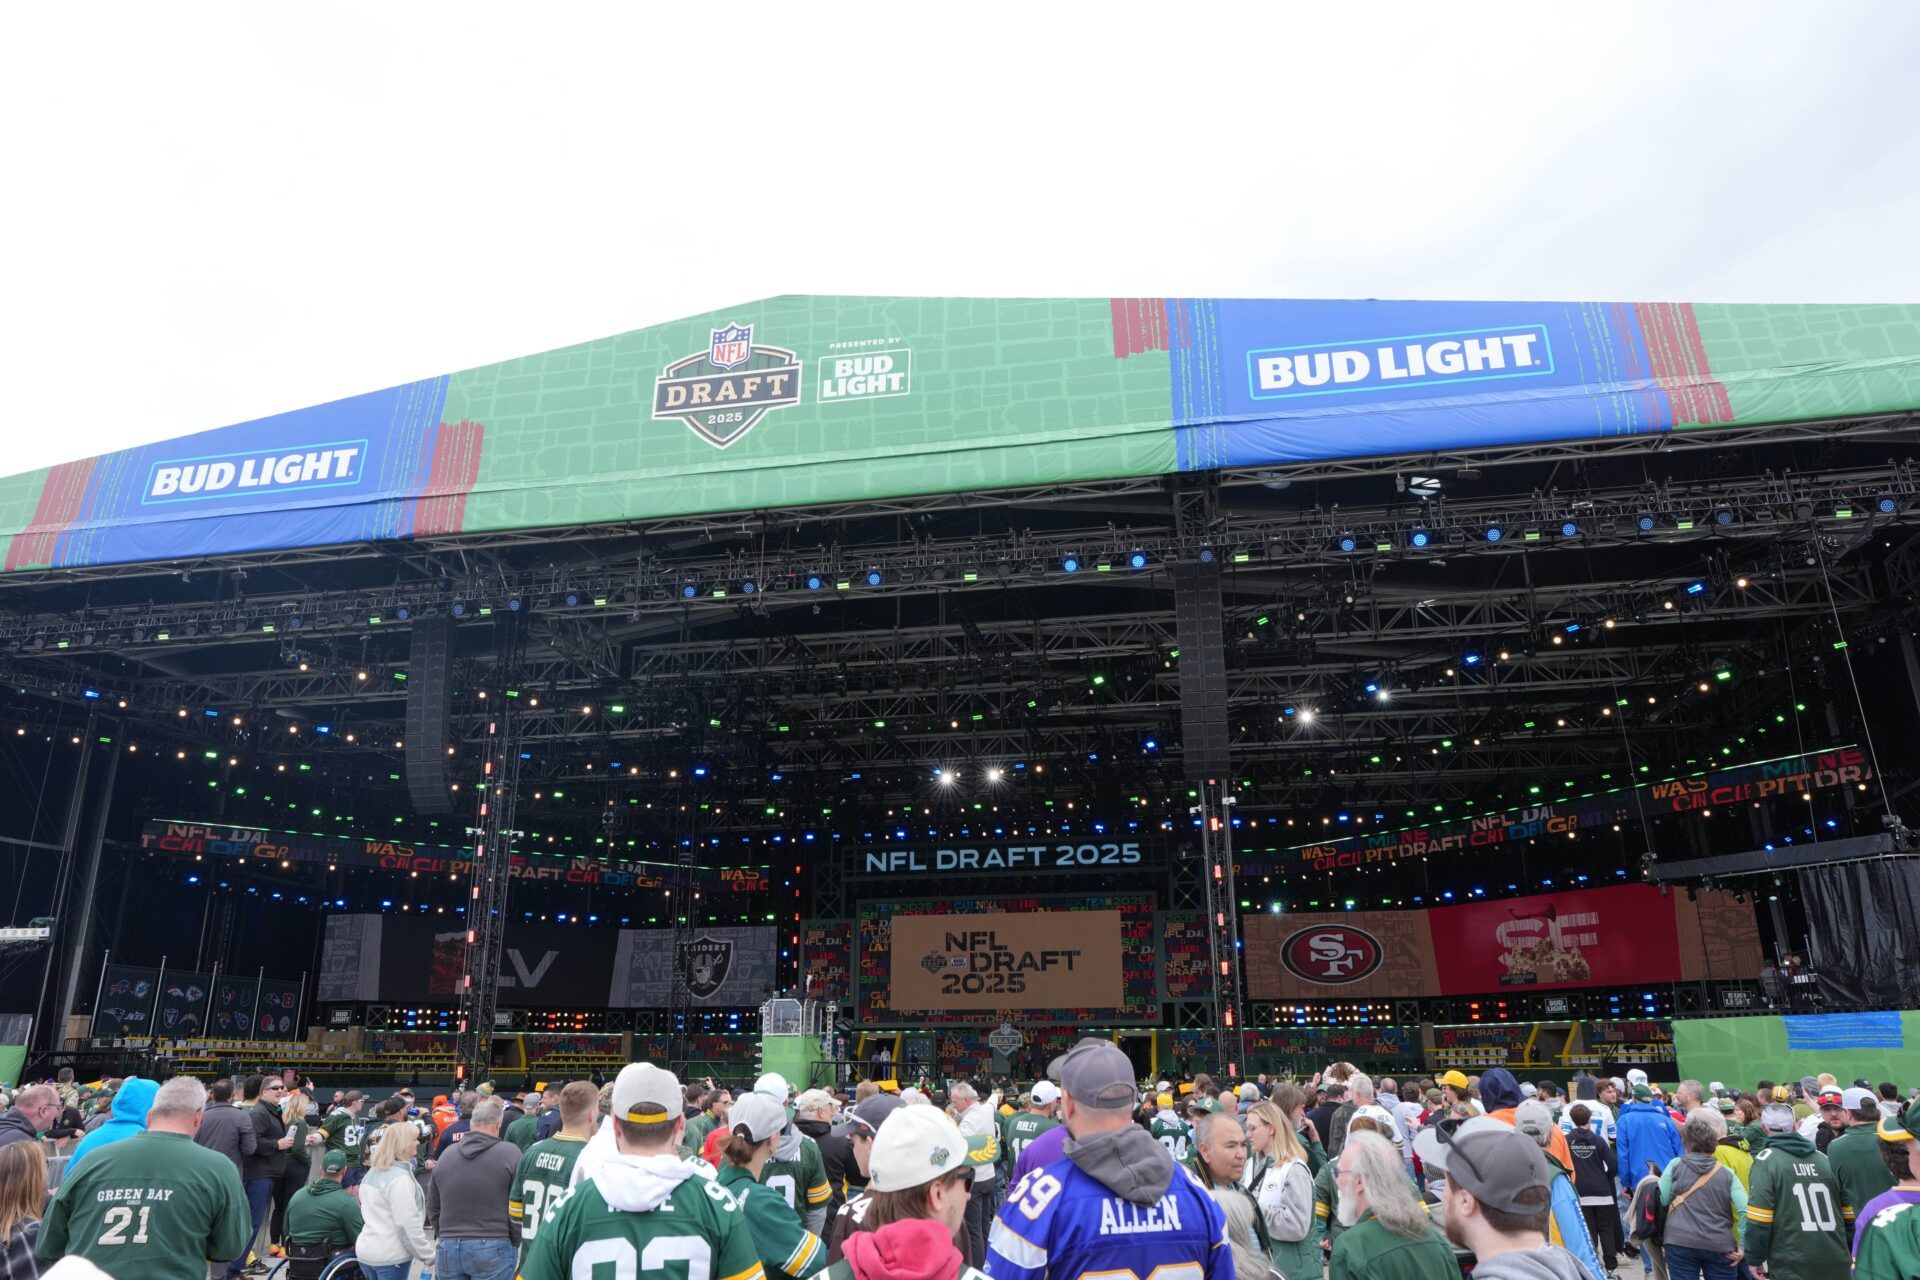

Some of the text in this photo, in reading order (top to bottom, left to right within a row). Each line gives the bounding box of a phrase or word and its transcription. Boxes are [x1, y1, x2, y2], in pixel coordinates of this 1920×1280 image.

[714, 340, 746, 363] NFL
[829, 340, 885, 350] PRESENTED
[835, 355, 894, 378] BUD
[1258, 333, 1542, 390] BUD LIGHT
[665, 373, 790, 407] DRAFT
[823, 373, 905, 398] LIGHT
[708, 412, 743, 425] 2025
[151, 448, 359, 496] BUD LIGHT
[1652, 777, 1709, 800] WAS
[1757, 773, 1810, 798] PIT
[1471, 804, 1557, 832] NFL DAL
[167, 822, 269, 845] NFL DAL
[365, 841, 414, 857] WAS
[866, 842, 1142, 872] NFL DRAFT 2025
[1301, 845, 1337, 861] WAS
[1364, 843, 1401, 864] PIT
[1399, 833, 1467, 858] DRAFT
[720, 868, 760, 881] WAS
[945, 931, 1008, 952] NFL
[969, 950, 1082, 973] DRAFT
[1308, 933, 1364, 976] SF
[942, 972, 1027, 994] 2025
[535, 1152, 566, 1172] GREEN
[1795, 1163, 1818, 1177] LOVE
[97, 1188, 174, 1202] GREEN BAY
[1007, 1166, 1063, 1222] 69
[1100, 1194, 1183, 1235] ALLEN
[1792, 1182, 1838, 1233] 10
[97, 1205, 151, 1246] 21
